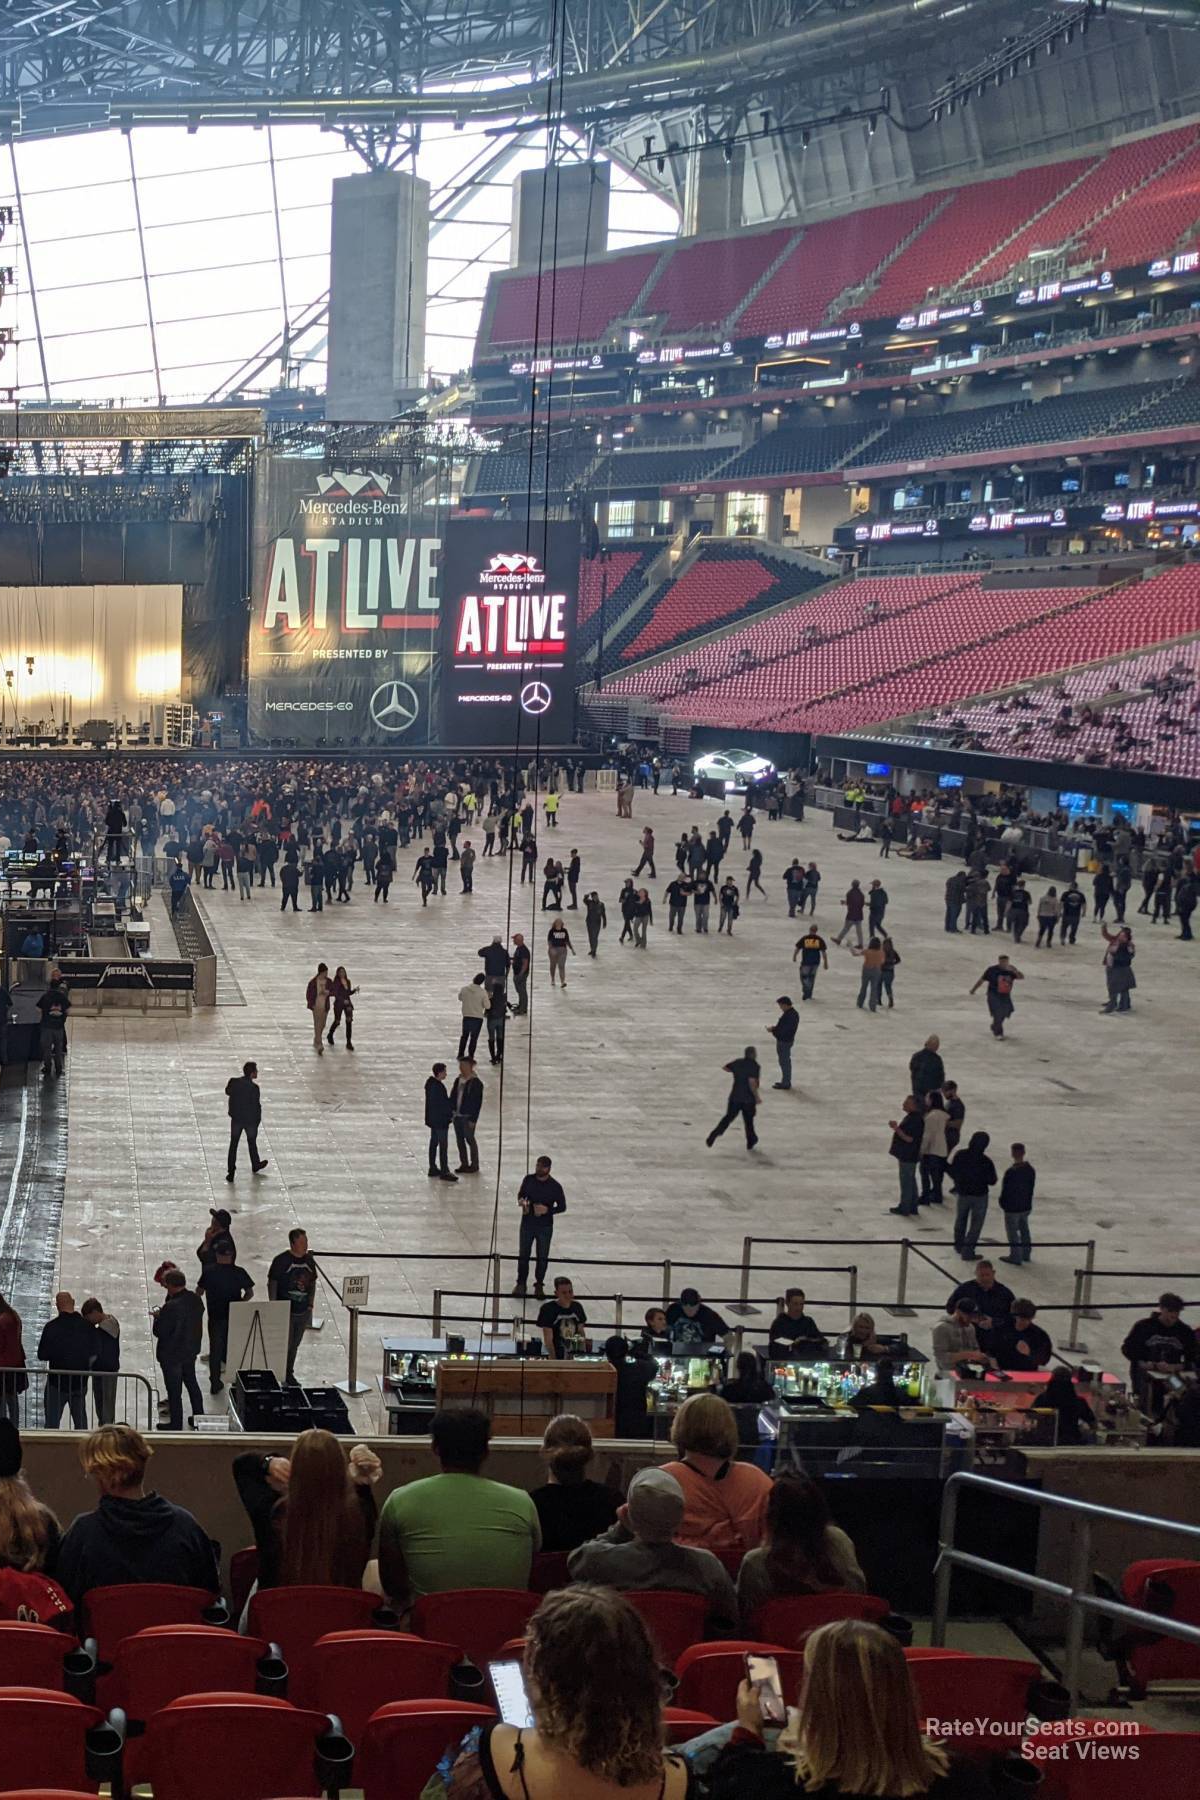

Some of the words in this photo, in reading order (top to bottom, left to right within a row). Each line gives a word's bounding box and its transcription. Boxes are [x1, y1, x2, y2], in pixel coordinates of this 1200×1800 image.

[299, 500, 408, 514] Mercedes-Benz
[322, 517, 383, 526] STADIUM
[263, 538, 442, 629] ATLIVE
[458, 595, 566, 652] ATLIVE
[312, 649, 373, 659] PRESENTED
[374, 649, 389, 659] BY
[265, 702, 354, 711] MERCEDES-EQ
[350, 1278, 363, 1286] EXIT
[346, 1286, 364, 1294] HERE
